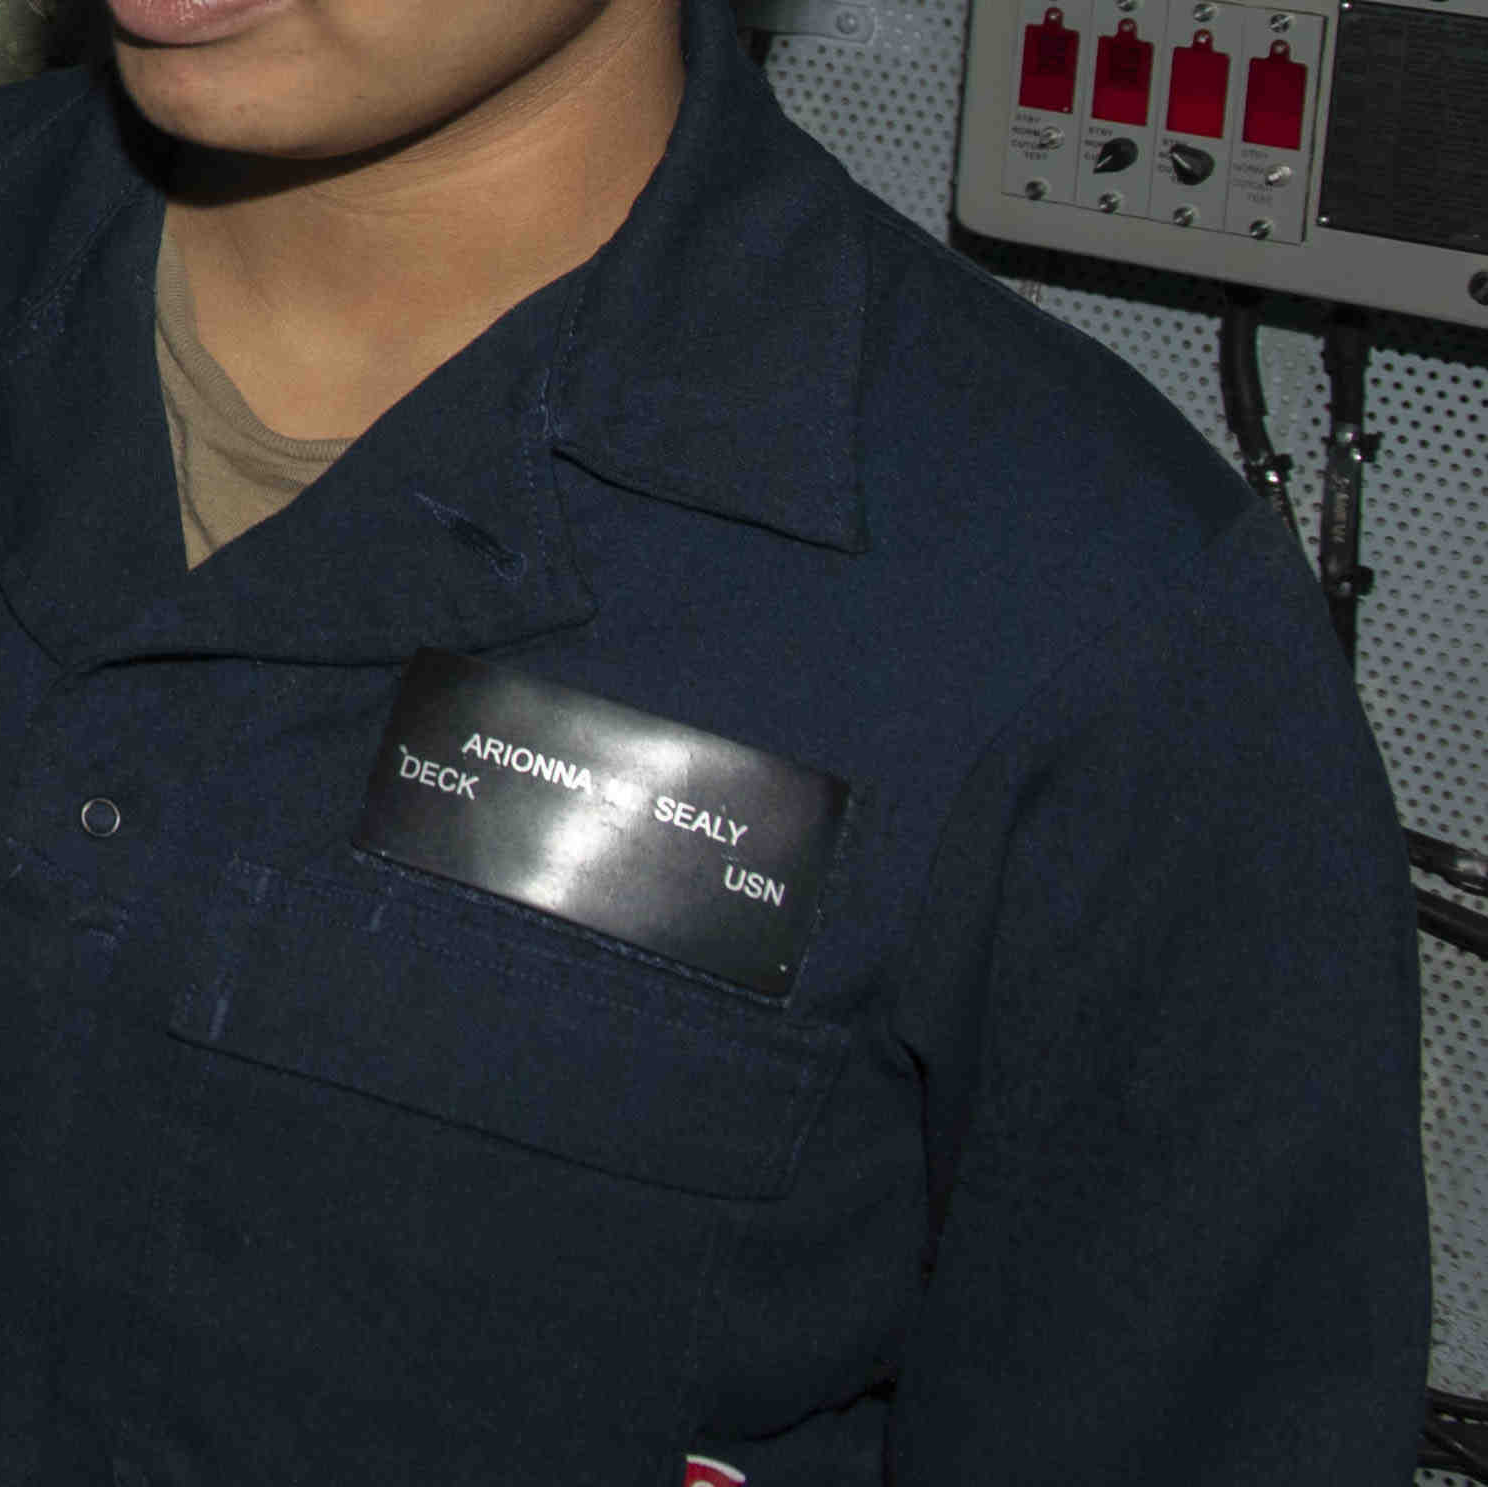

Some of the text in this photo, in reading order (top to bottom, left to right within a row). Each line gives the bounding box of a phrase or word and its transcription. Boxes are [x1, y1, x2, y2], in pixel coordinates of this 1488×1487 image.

[400, 754, 480, 800] DECK
[462, 732, 593, 796] ARIONNA
[655, 795, 748, 847] SEALY
[723, 863, 785, 907] USN
